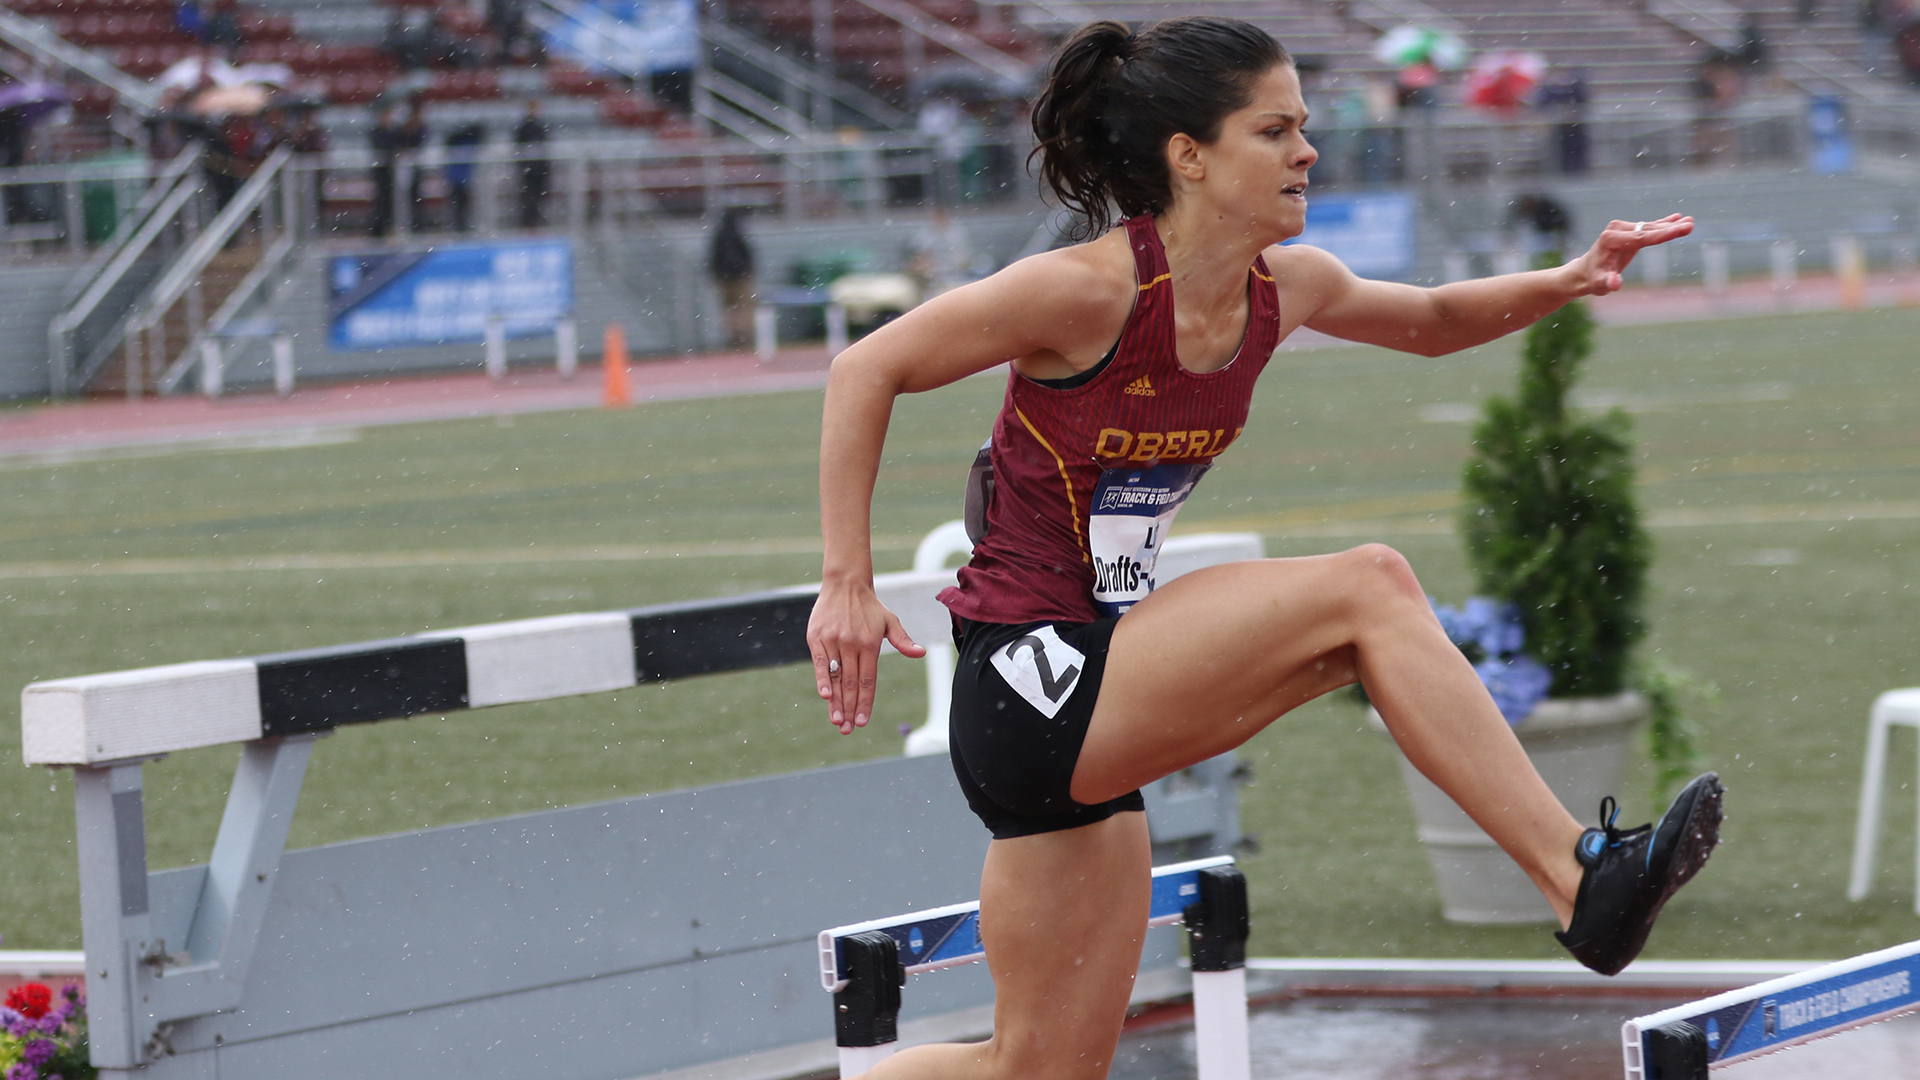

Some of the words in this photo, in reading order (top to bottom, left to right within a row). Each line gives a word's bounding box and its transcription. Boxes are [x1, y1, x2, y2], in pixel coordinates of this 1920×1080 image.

[1124, 386, 1156, 396] adidas
[1119, 492, 1148, 503] TRACK
[1147, 494, 1156, 505] &
[1095, 555, 1152, 593] Drafts-
[1005, 635, 1080, 704] 2
[1779, 999, 1808, 1030] TRACK
[1815, 990, 1840, 1019] FIELD
